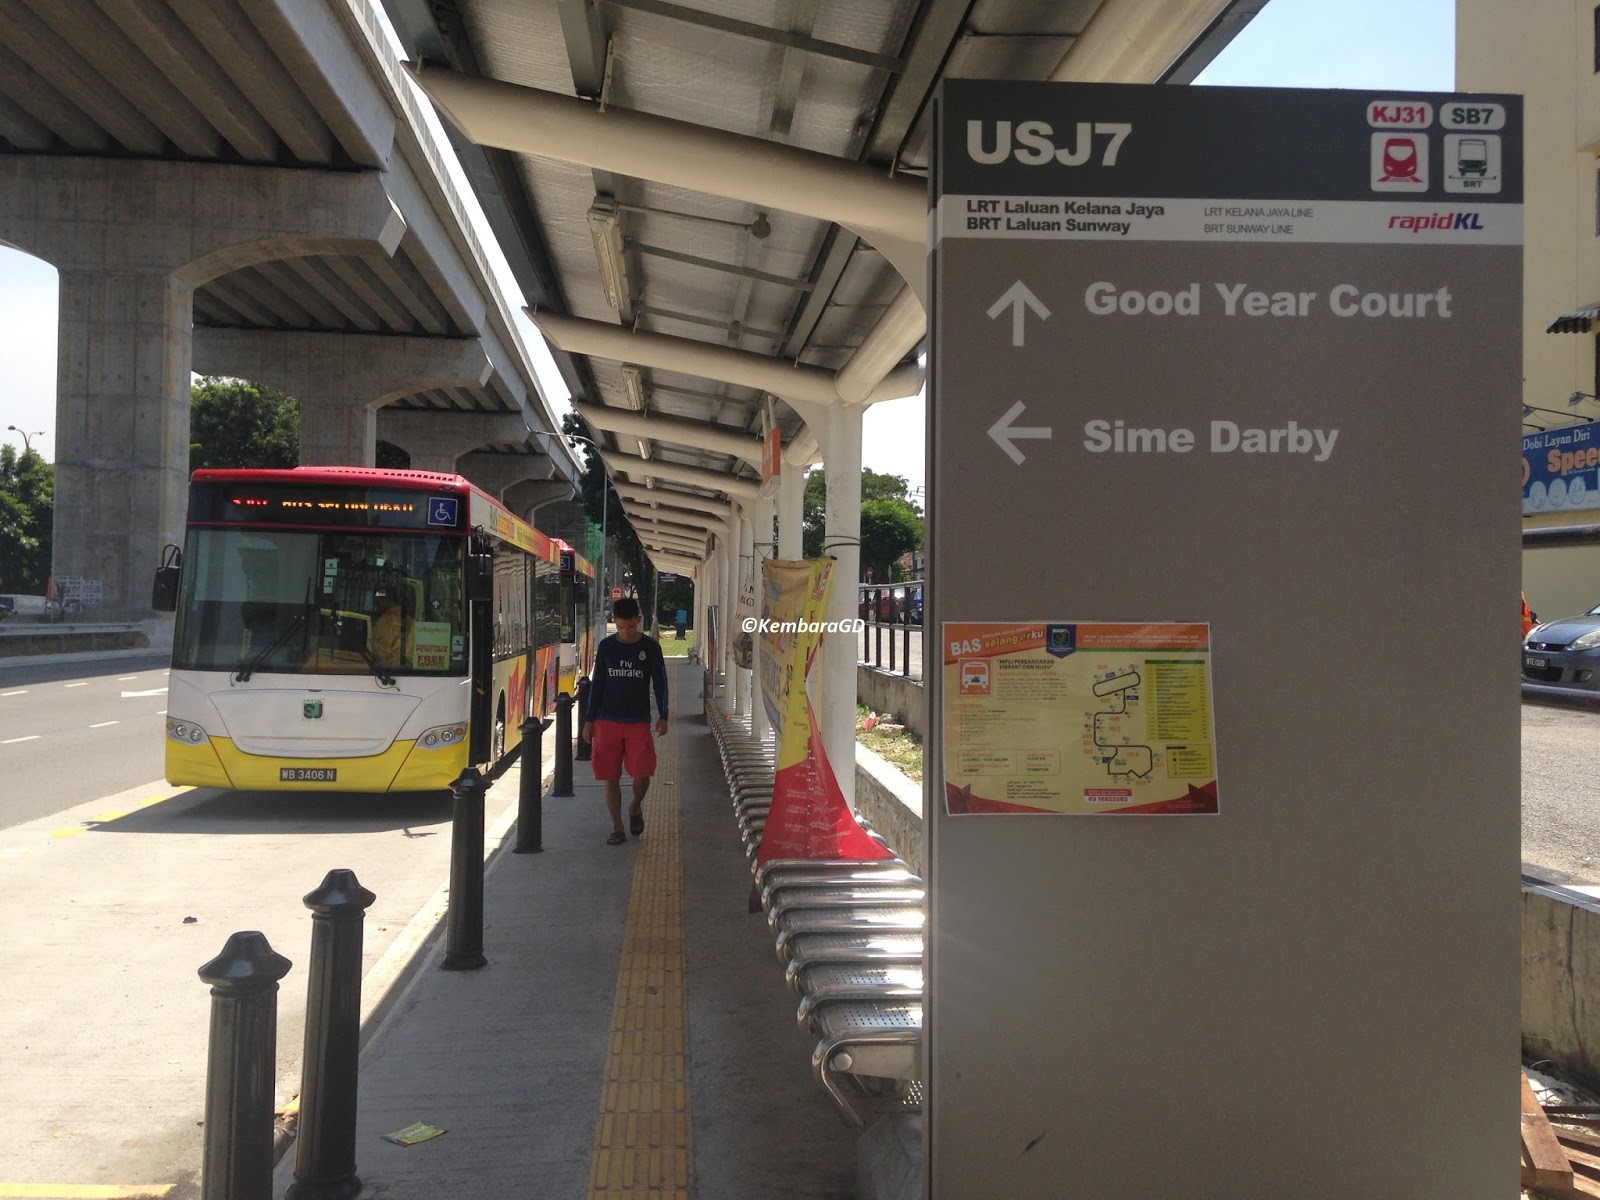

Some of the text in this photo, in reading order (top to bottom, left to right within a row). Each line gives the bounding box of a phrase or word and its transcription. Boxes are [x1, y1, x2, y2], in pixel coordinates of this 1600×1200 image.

[1372, 106, 1426, 123] KJ31
[1451, 107, 1494, 125] SB7
[966, 119, 1132, 167] USJ7
[1463, 180, 1483, 188] BRT
[966, 199, 1165, 219] LRT Laluan Kelana Jaya
[1204, 207, 1314, 218] LRT KELANA JAYA LINE
[966, 216, 1131, 236] BRT Laluan Sunway
[1204, 224, 1294, 234] BRT SUNWAY LINE
[1388, 212, 1485, 233] rapidKL
[1084, 281, 1453, 318] Good Year Court
[1083, 419, 1340, 462] Sime Darby
[1522, 428, 1591, 451] Dobi Layan Diri
[1547, 447, 1600, 476] Spee
[950, 637, 982, 656] BAS
[417, 655, 446, 663] FREE
[620, 660, 633, 669] Fly
[608, 667, 644, 678] Emirates
[282, 770, 334, 780] WB 3406 N
